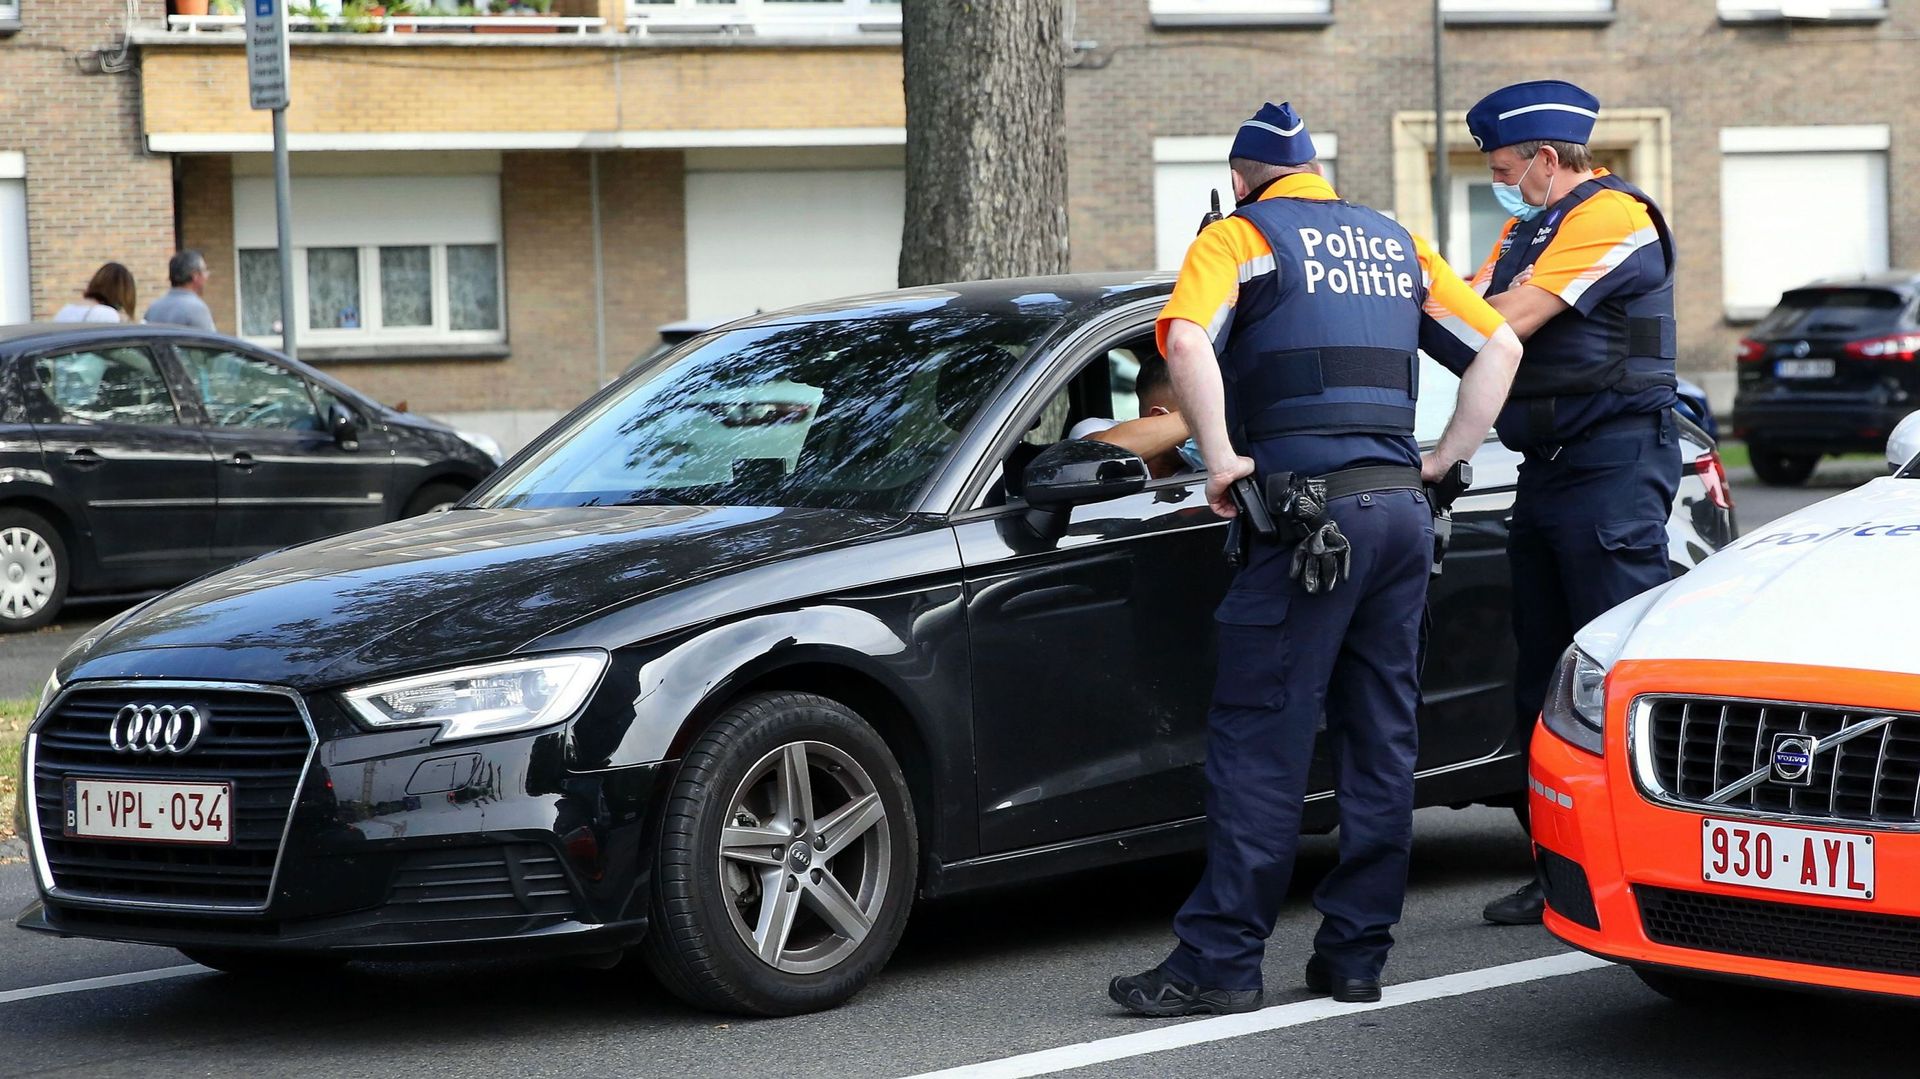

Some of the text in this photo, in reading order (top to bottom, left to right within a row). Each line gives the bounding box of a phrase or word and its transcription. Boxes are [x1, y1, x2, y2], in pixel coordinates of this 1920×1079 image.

[1299, 225, 1405, 262] Police
[1304, 260, 1413, 299] Politie
[1777, 754, 1807, 763] VOLVO
[67, 810, 76, 827] B
